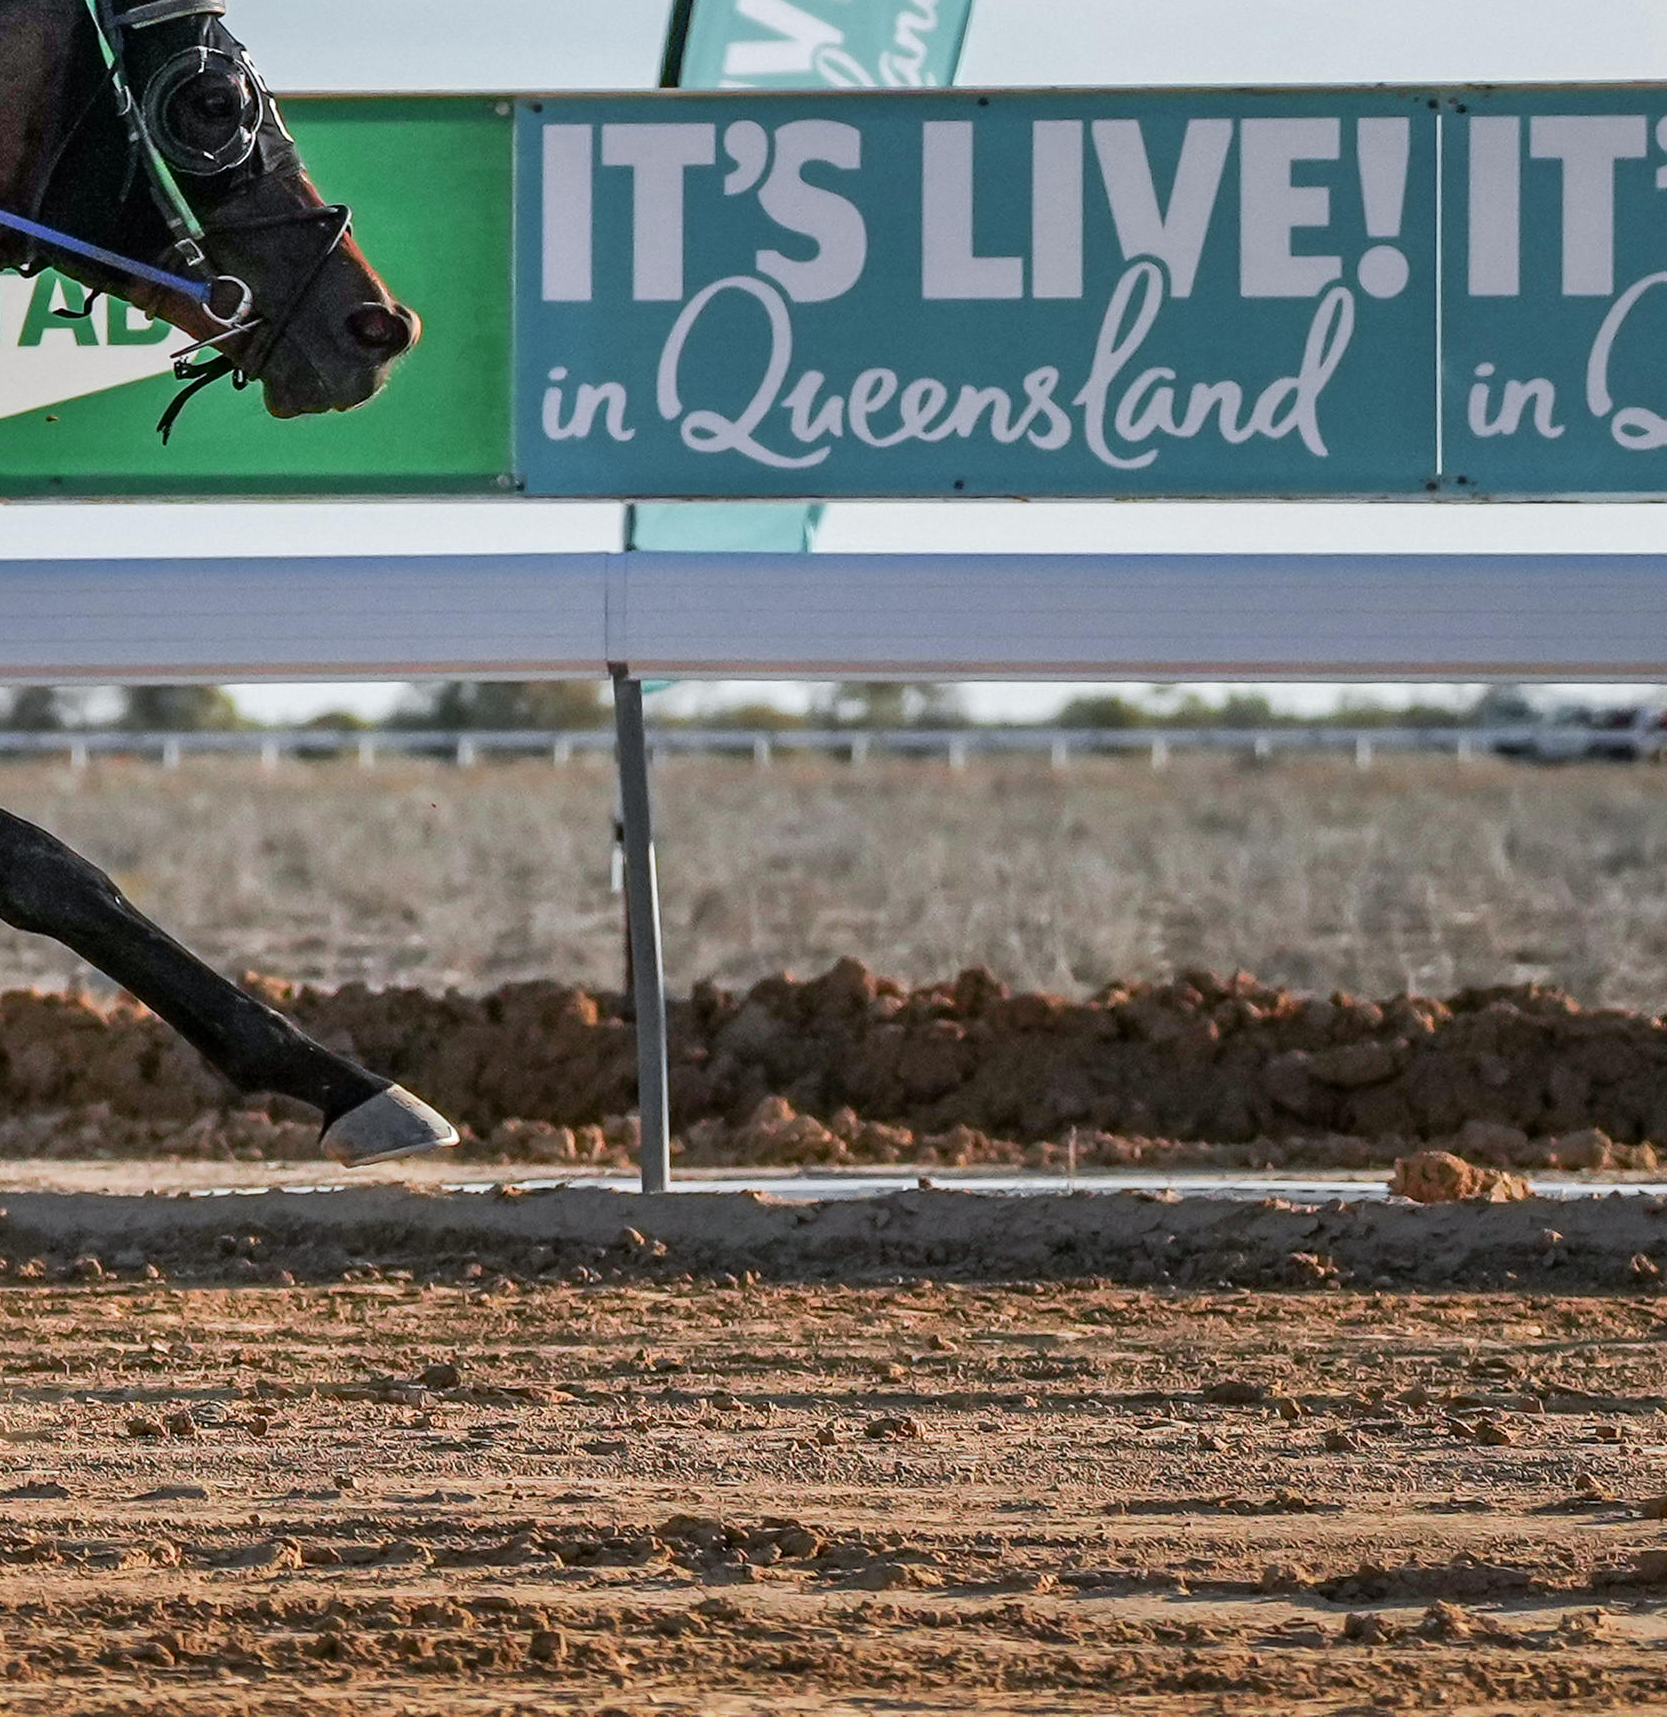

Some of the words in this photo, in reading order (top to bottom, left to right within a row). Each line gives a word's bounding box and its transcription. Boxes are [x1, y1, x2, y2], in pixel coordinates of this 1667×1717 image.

[541, 118, 868, 303] IT'S
[922, 116, 1411, 300] LIVE!
[1468, 114, 1667, 298] IT
[541, 365, 635, 443] in
[657, 256, 1355, 470] Queensland
[1468, 361, 1566, 440] in
